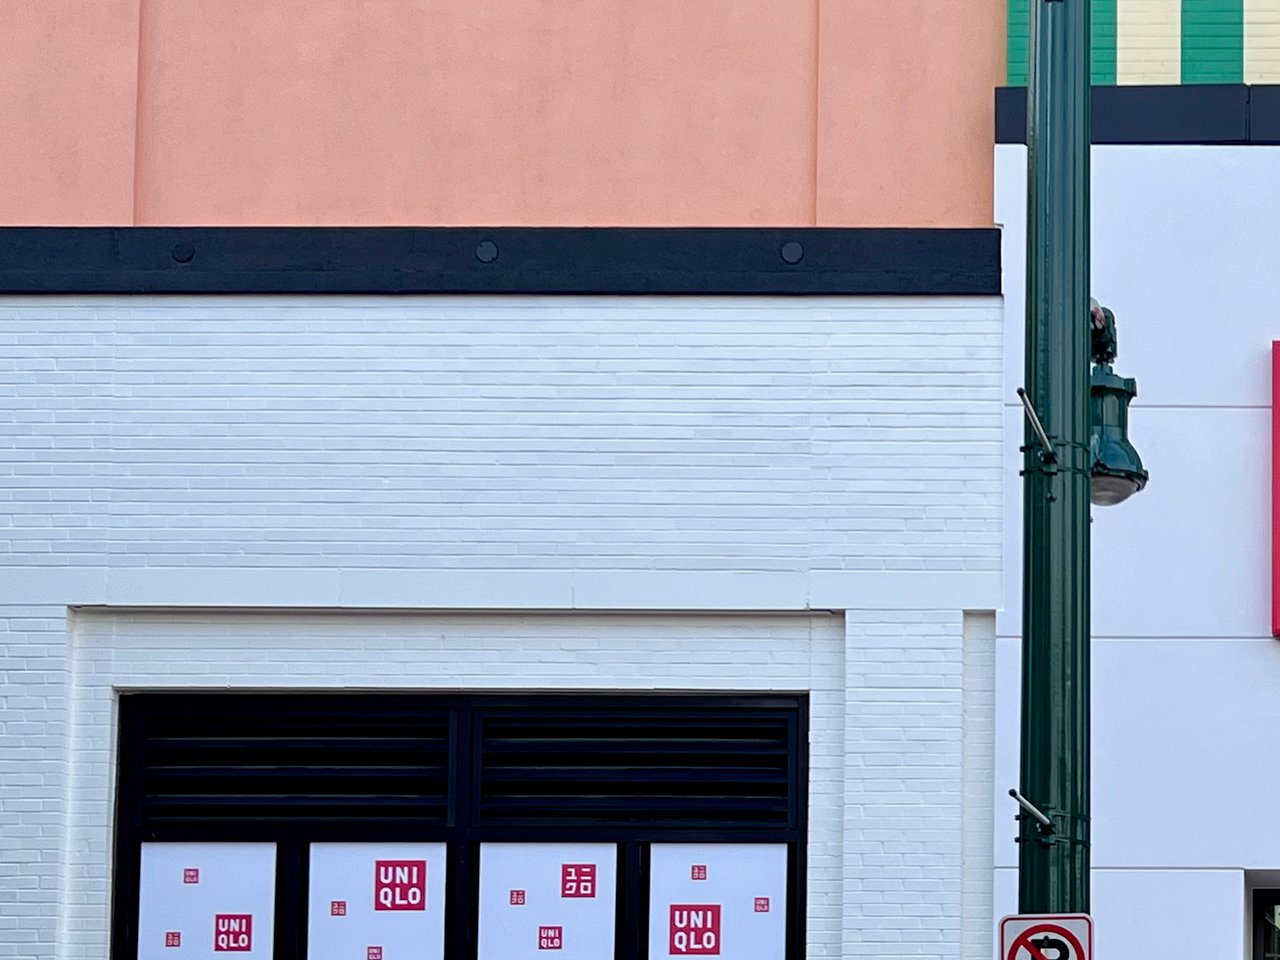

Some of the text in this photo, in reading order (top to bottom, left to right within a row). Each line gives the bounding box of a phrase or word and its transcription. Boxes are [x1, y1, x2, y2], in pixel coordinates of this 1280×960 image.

[379, 866, 418, 884] UNI
[379, 887, 421, 908] QLO
[218, 919, 247, 932] UNI
[674, 910, 712, 928] UNI
[541, 928, 559, 937] UNI
[218, 934, 249, 950] QLO
[541, 938, 560, 948] QLO
[674, 931, 716, 952] QLO
